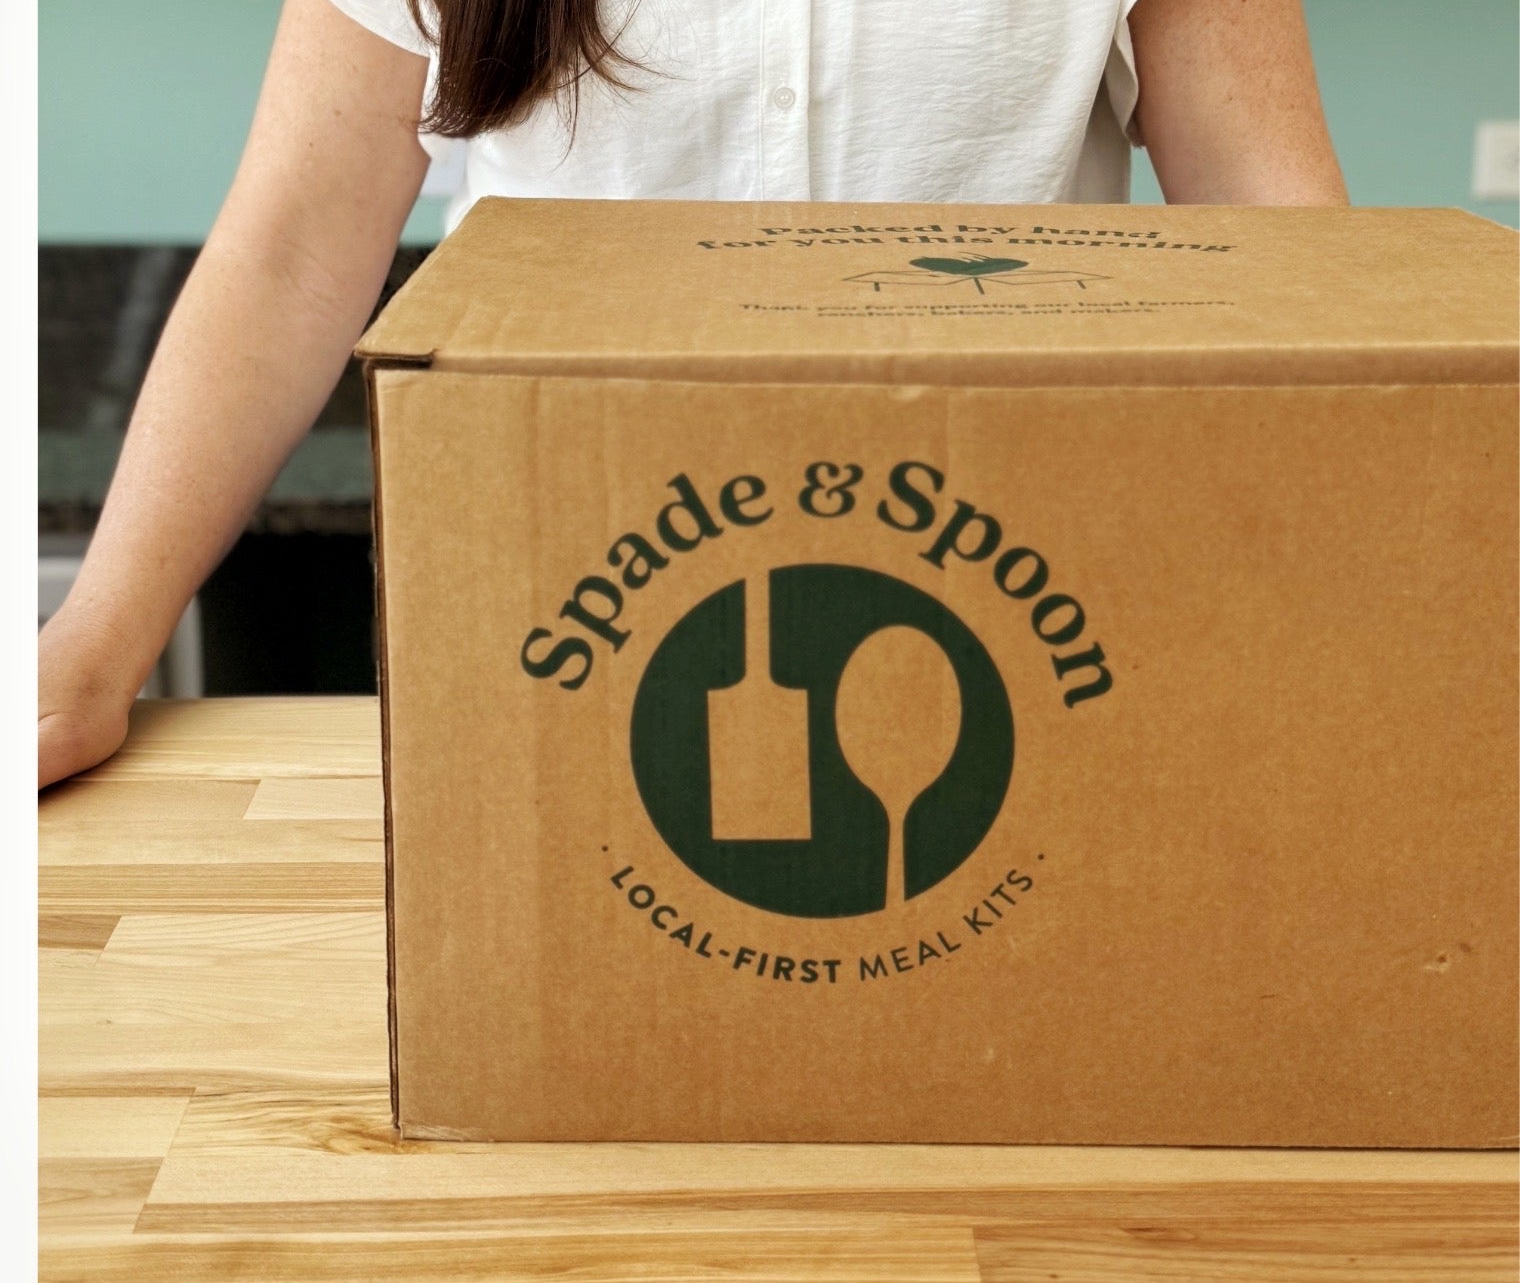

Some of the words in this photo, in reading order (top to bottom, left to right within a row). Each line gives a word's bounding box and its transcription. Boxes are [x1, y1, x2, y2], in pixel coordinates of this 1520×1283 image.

[697, 239, 777, 249] for
[790, 237, 884, 247] you
[896, 235, 993, 244] this
[1009, 238, 1238, 252] morning
[759, 224, 943, 235] Packed
[957, 225, 1016, 234] by
[1033, 226, 1161, 238] hand
[520, 473, 774, 691] Spade
[798, 461, 864, 518] &
[876, 461, 1114, 710] Spoon
[610, 865, 842, 984] LOCAL-FIRST
[861, 931, 961, 982] MEAL
[962, 868, 1035, 935] KITS
